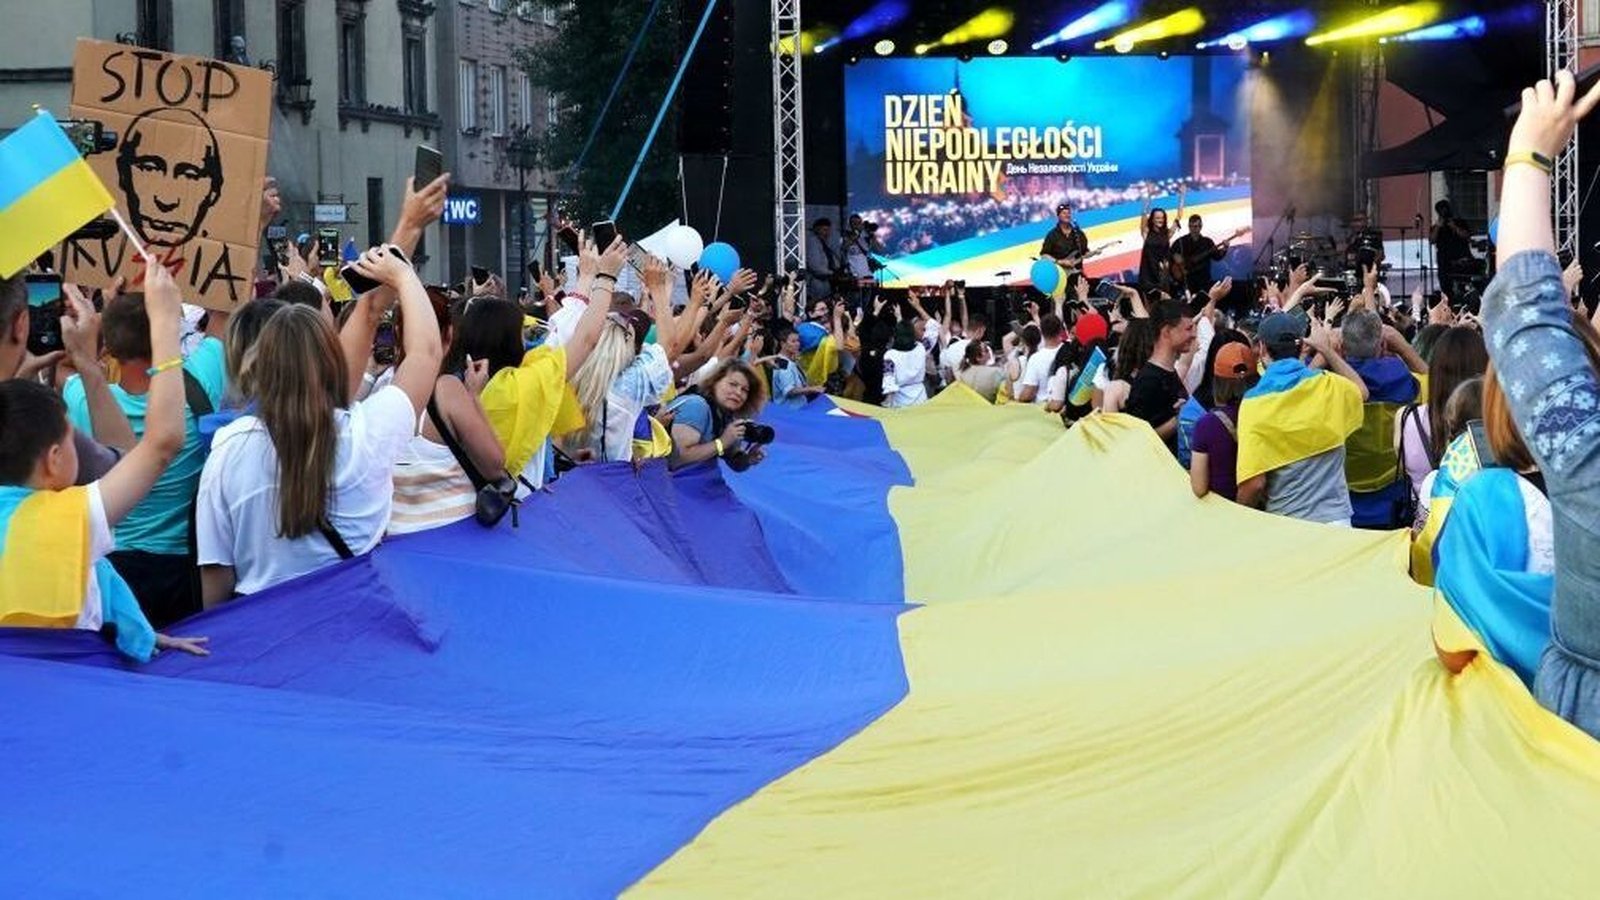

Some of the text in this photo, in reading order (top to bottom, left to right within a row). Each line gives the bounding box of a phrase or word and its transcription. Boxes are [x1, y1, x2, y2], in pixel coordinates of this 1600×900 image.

[101, 51, 240, 112] STOP
[884, 88, 962, 128] DZIEŃ
[885, 120, 1103, 162] NIEPODLEGŁOŚCI
[885, 161, 1002, 195] UKRAINY
[1006, 162, 1027, 175] День
[1087, 161, 1118, 173] України
[450, 200, 477, 219] WC
